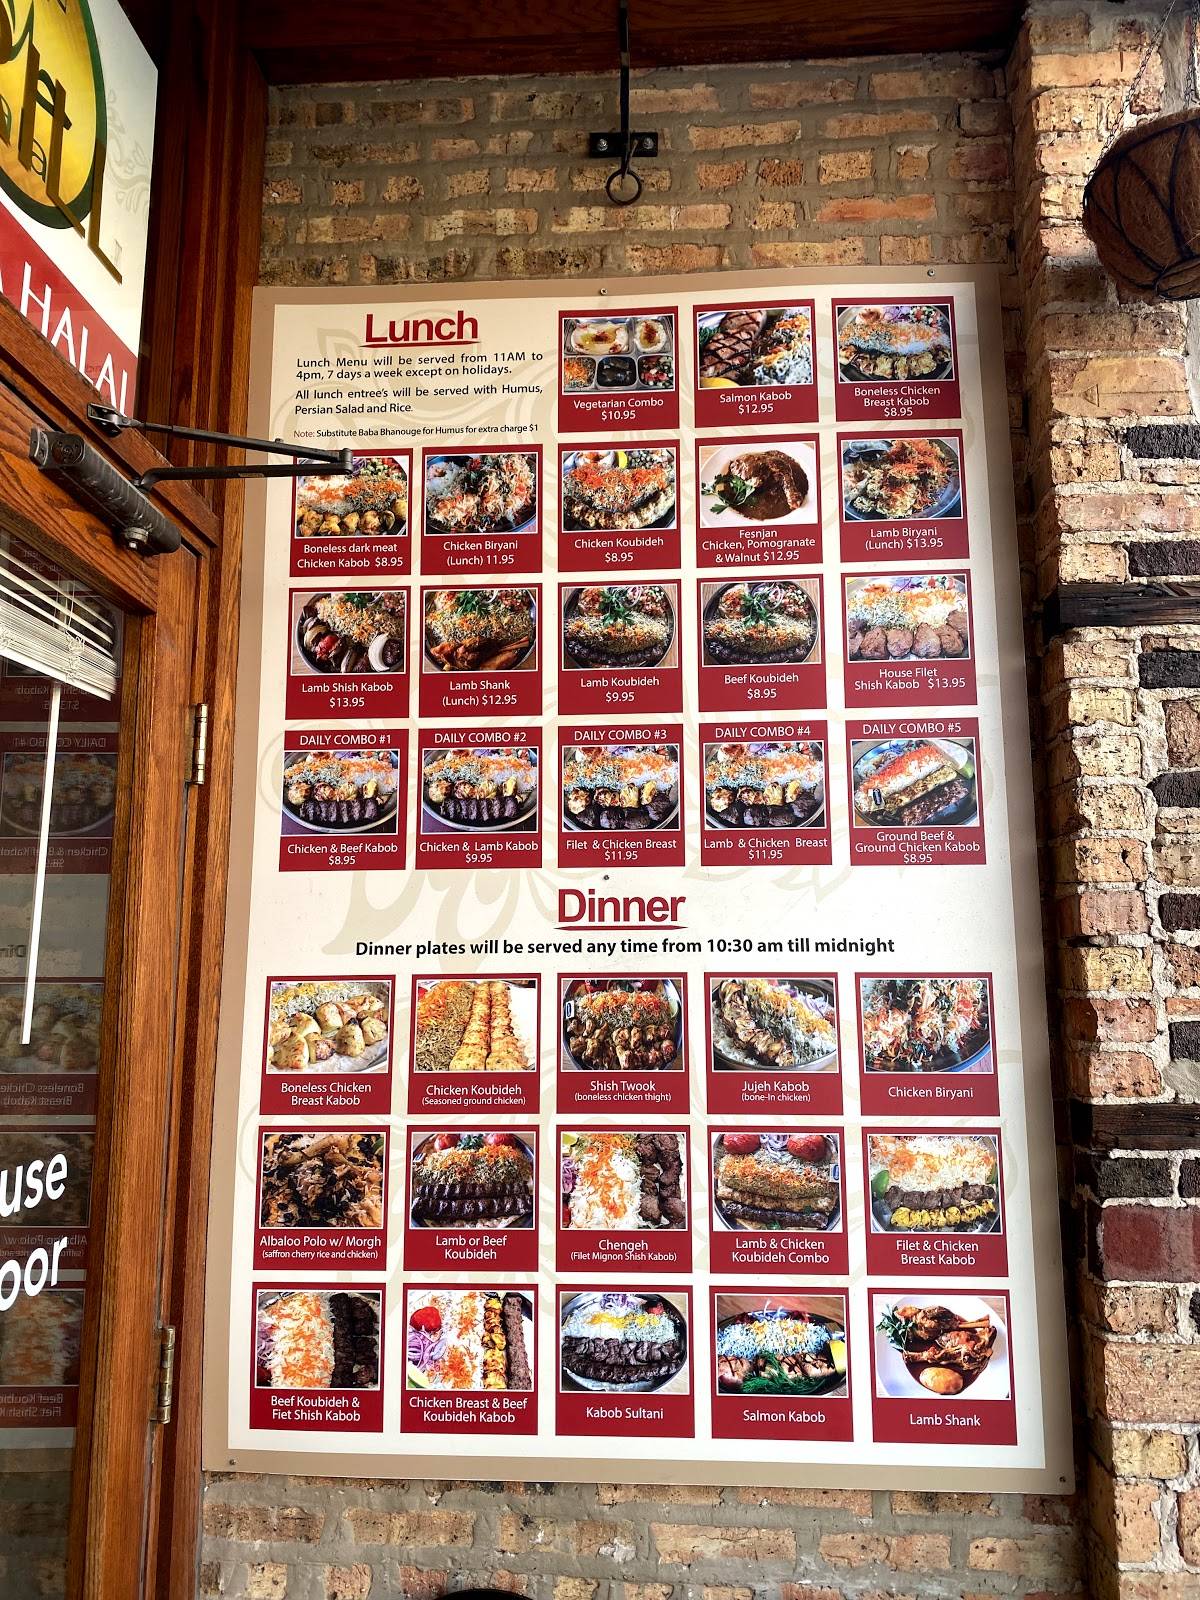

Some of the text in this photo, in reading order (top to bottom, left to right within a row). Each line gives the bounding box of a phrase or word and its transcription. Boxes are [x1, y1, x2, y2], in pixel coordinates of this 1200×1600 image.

[365, 309, 478, 343] Lunch
[296, 351, 543, 367] Lunch Menu will be served from 11AM to
[295, 365, 512, 381] 4pm, 7 days a week except on holidays.
[295, 384, 543, 399] All lunch entree's will be served with Humus,
[854, 385, 940, 396] Boneless Chicken
[573, 397, 663, 410] Vegetarian Combo
[863, 396, 929, 407] Breast Kabob
[294, 404, 333, 415] Persian
[335, 403, 364, 414] Salad
[366, 402, 387, 413] and
[883, 406, 913, 417] $8.95
[601, 409, 636, 421] $10.95
[316, 429, 357, 437] Substitute
[358, 427, 379, 436] Baba
[379, 427, 421, 436] Bhanouge
[422, 426, 434, 434] for
[435, 426, 464, 434] Humus
[464, 425, 477, 433] for
[477, 425, 499, 433] extra
[499, 424, 528, 434] charge
[528, 423, 538, 432] $1
[739, 528, 777, 539] Fesnjan
[303, 542, 397, 553] Boneless dark meat
[701, 537, 815, 550] Chicken, Pomogranate
[296, 556, 403, 568] Chicken Kabob $8.95
[714, 549, 800, 564] & Walnut $12.95
[879, 667, 938, 679] House Filet
[302, 681, 393, 692] Lamb Shish Kabob
[854, 677, 965, 690] Shish Kabob $13.95
[329, 696, 364, 708] $13.95
[862, 722, 961, 734] DAILY COMBO #5
[299, 734, 390, 745] DAILY COMBO #1
[876, 830, 955, 841] Ground Beef &
[287, 842, 398, 854] Chicken & Beef Kabob
[854, 840, 980, 852] Ground Chicken Kabob
[328, 854, 355, 866] $8.95
[903, 852, 932, 864] $8.95
[557, 888, 686, 926] Dinner
[355, 937, 894, 958] Dinner plates will be served any time from 10:30 am till midnight
[281, 1081, 371, 1093] Boneless Chicken
[425, 1084, 522, 1095] Chicken Koubideh
[590, 1080, 656, 1091] Shish Twook
[291, 1094, 360, 1105] Breast Kabob
[421, 1095, 525, 1106] (Seasoned ground chicken)
[574, 1092, 611, 1101] (boneless
[612, 1092, 643, 1100] chicken
[0, 1153, 68, 1218] use
[259, 1234, 381, 1249] Albaloo Polo w/ Morgh
[435, 1234, 507, 1246] Lamb or Beef
[598, 1238, 648, 1252] Chengeh
[896, 1239, 978, 1251] Filet & Chicken
[316, 1250, 330, 1258] rice
[330, 1249, 346, 1258] and
[346, 1249, 378, 1259] chicken)
[444, 1247, 497, 1259] Koubideh
[570, 1250, 677, 1262] (Filet Mignon Shish Kabob)
[900, 1253, 975, 1265] Breast Kabob
[0, 1236, 68, 1312] oor
[270, 1395, 360, 1408] Beef Koubideh &
[272, 1408, 360, 1421] Fiet Shish Kabob
[743, 1409, 825, 1423] Salmon Kabob
[909, 1413, 980, 1426] Lamb Shank
